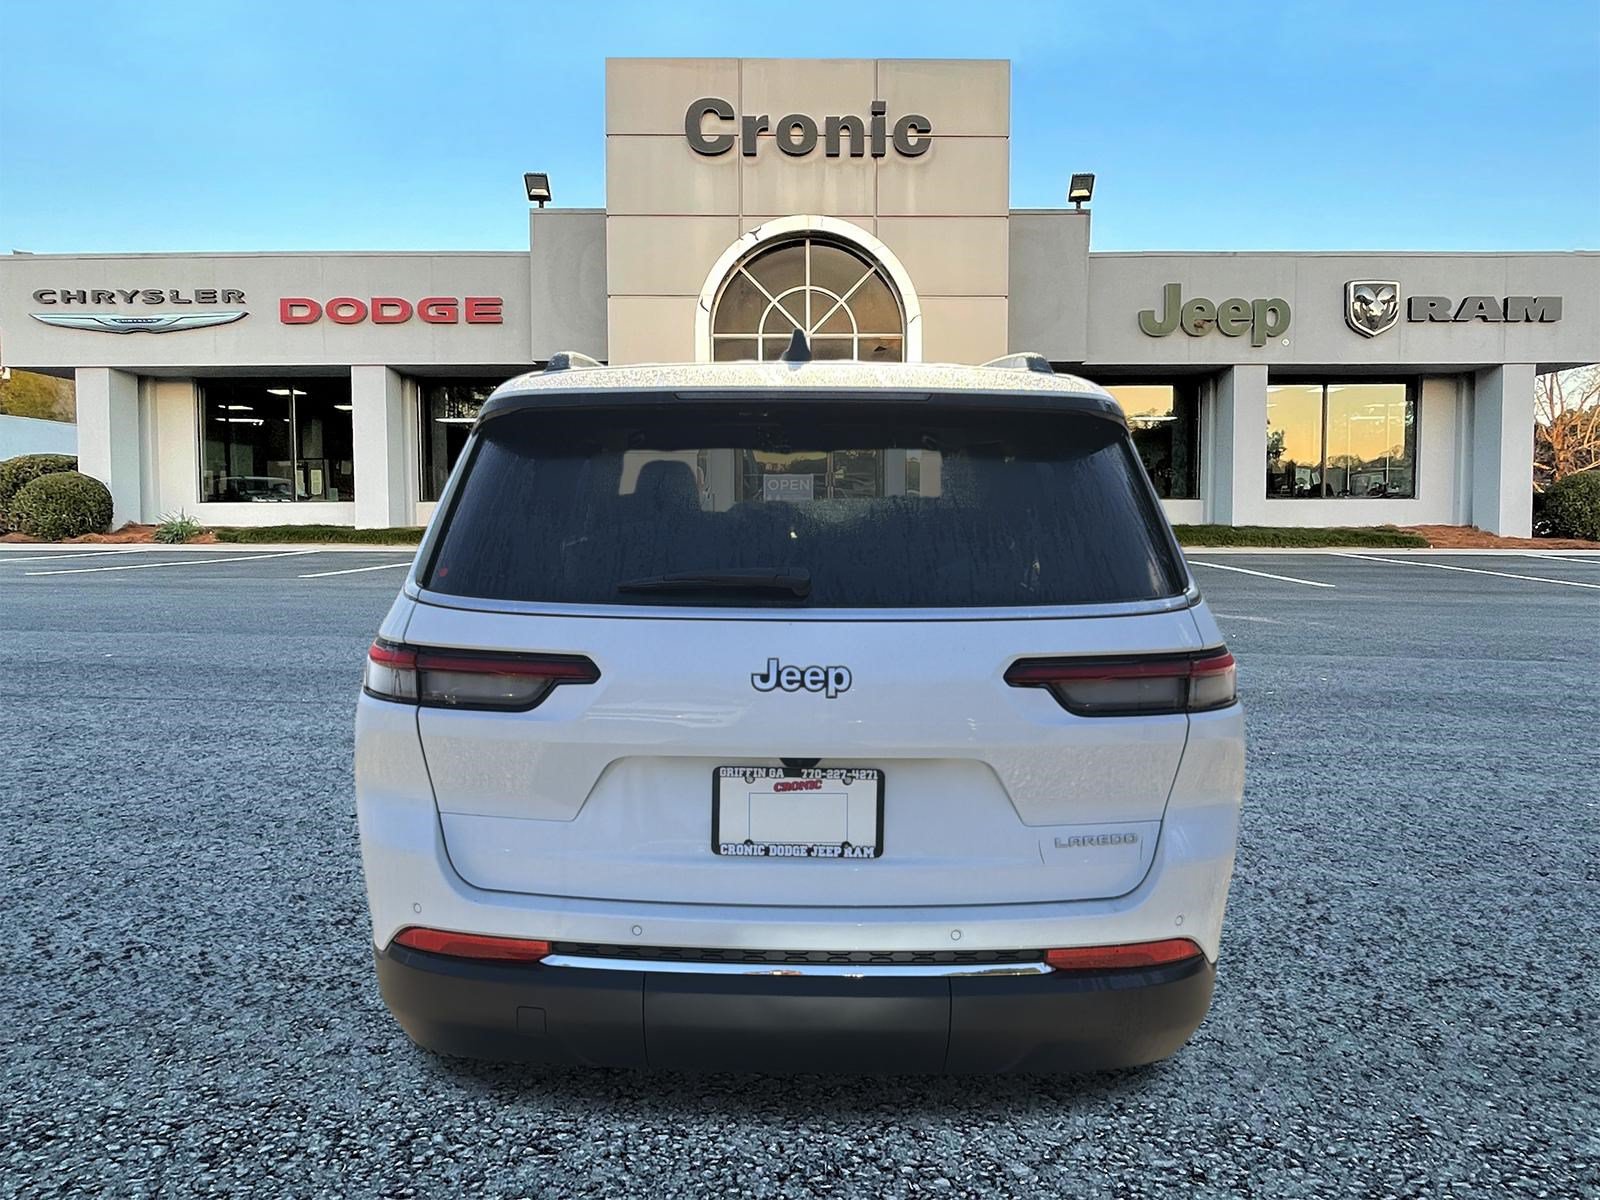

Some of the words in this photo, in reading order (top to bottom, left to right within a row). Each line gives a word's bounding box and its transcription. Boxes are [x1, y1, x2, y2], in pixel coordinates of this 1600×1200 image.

[685, 97, 932, 157] Cronic
[32, 289, 246, 305] CHRYSLER
[279, 297, 503, 324] DODGE
[1138, 283, 1291, 347] Jeep
[1407, 296, 1563, 322] RAM
[767, 479, 810, 490] OPEN
[751, 658, 852, 698] Jeep
[719, 767, 766, 778] GRIFFIN
[769, 768, 785, 779] GA
[801, 768, 878, 780] 770-227-4271
[773, 780, 823, 792] CRONIC
[1055, 833, 1138, 848] LAREDO
[719, 844, 766, 856] CRONIC
[768, 844, 808, 857] DODGE
[810, 845, 842, 858] JEEP
[843, 847, 875, 858] RAM
